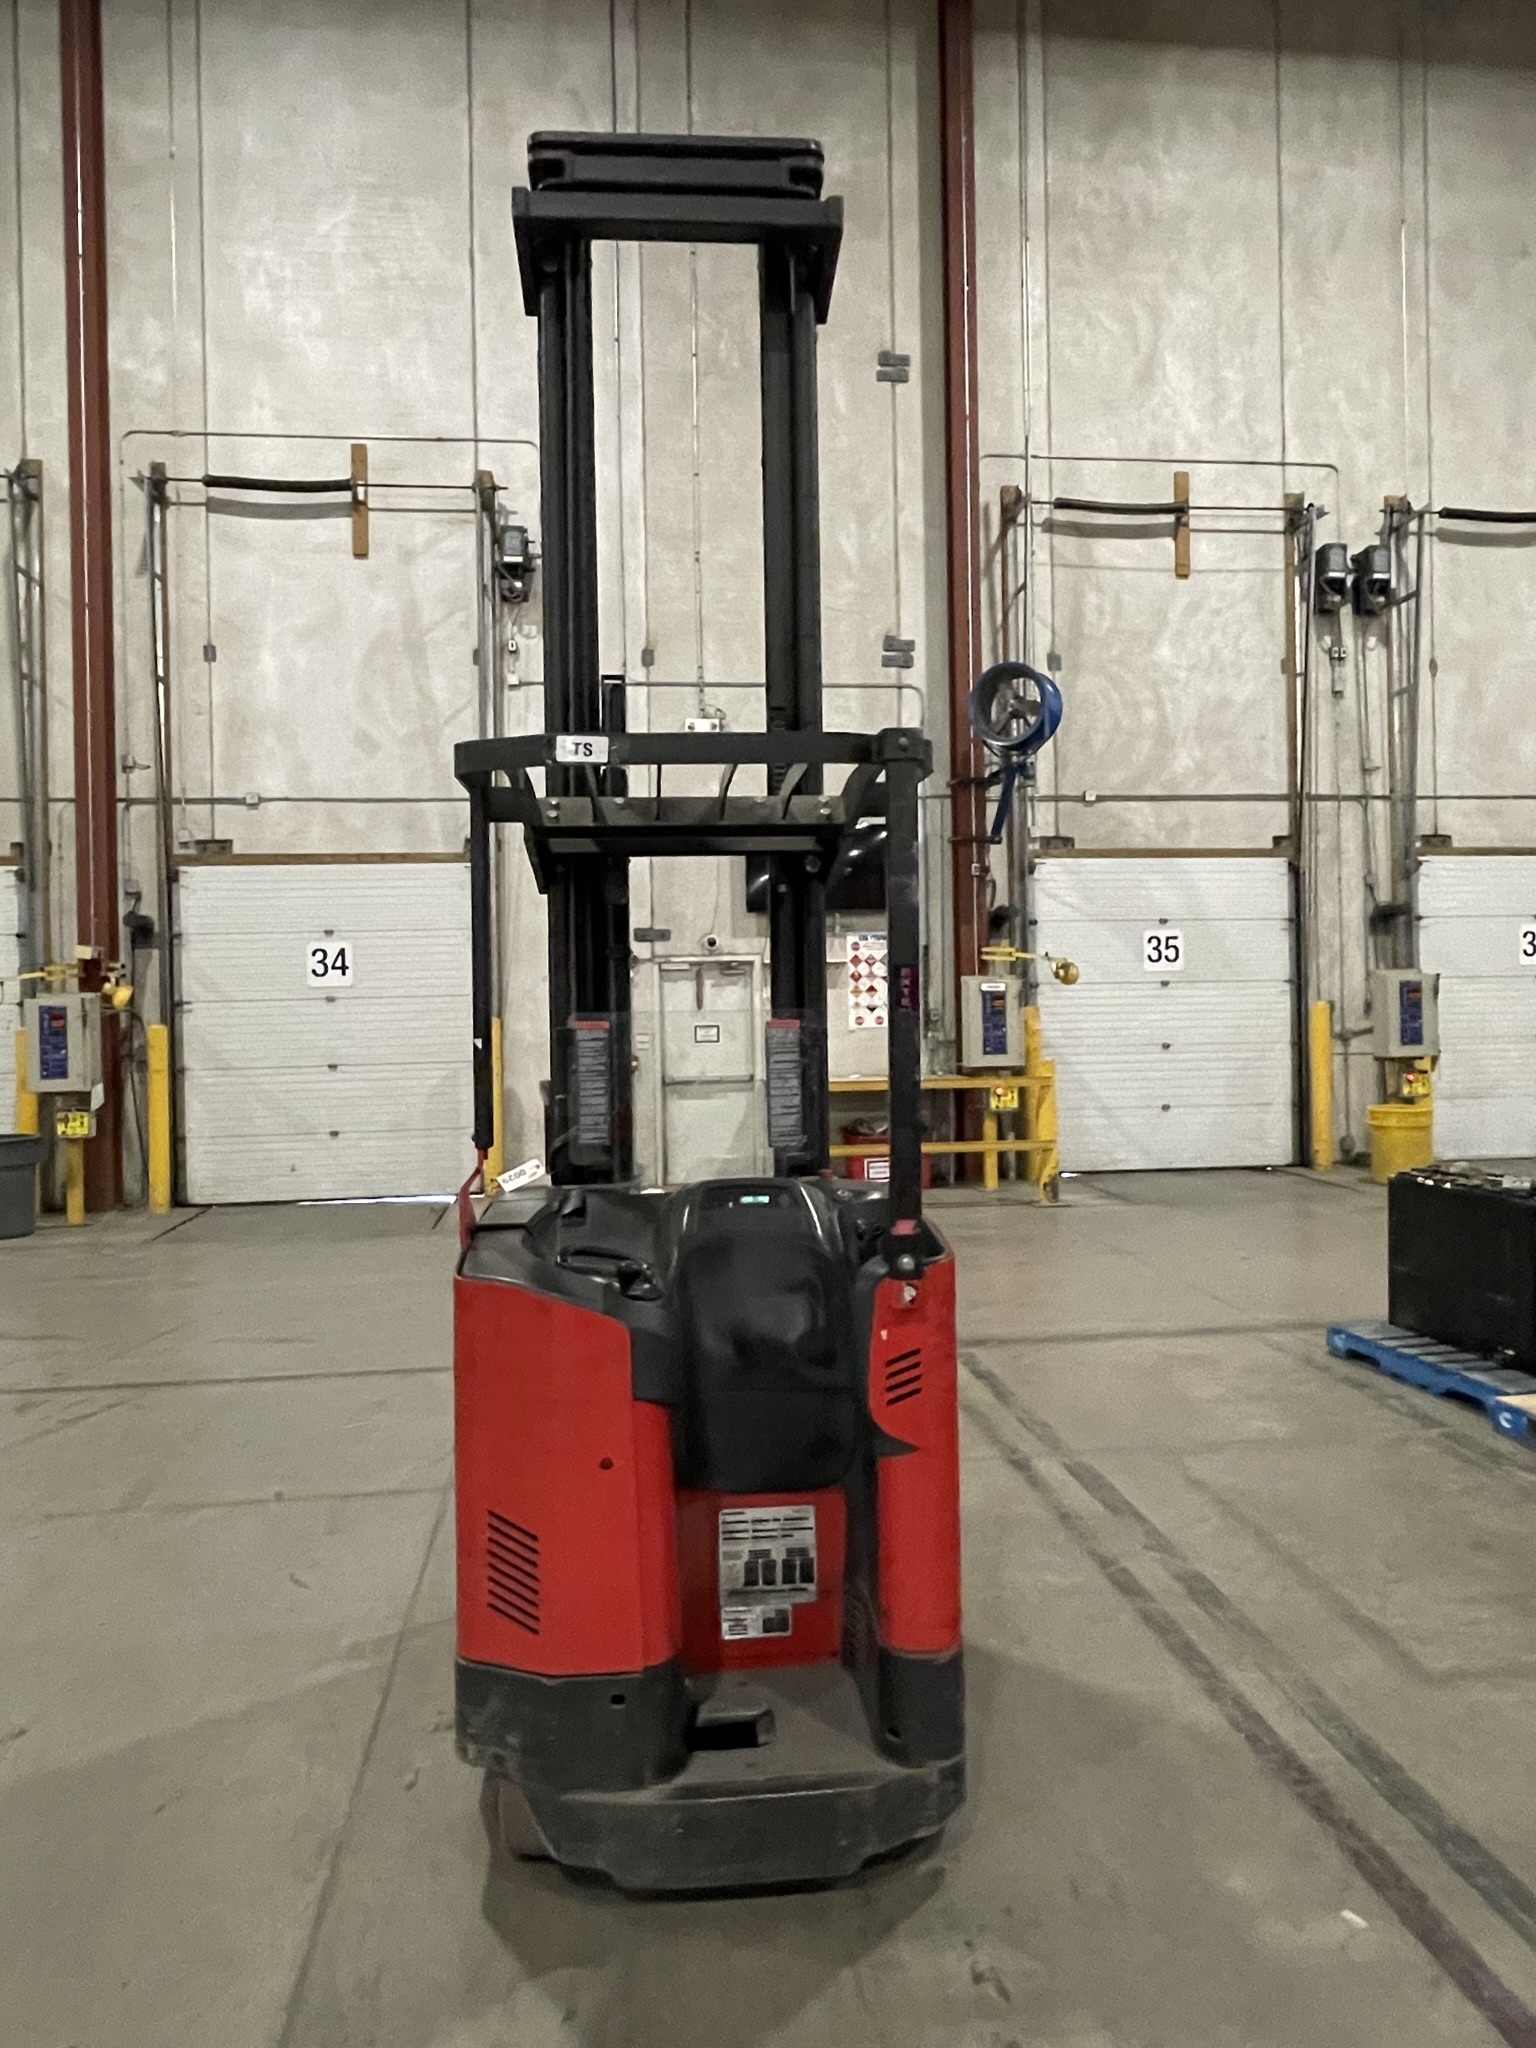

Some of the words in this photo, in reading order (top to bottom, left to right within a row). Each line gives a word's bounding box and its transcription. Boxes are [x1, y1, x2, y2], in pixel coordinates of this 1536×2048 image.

[571, 742, 593, 757] TS
[1147, 935, 1180, 963] 35
[1522, 930, 1536, 957] 3
[311, 947, 350, 978] 34
